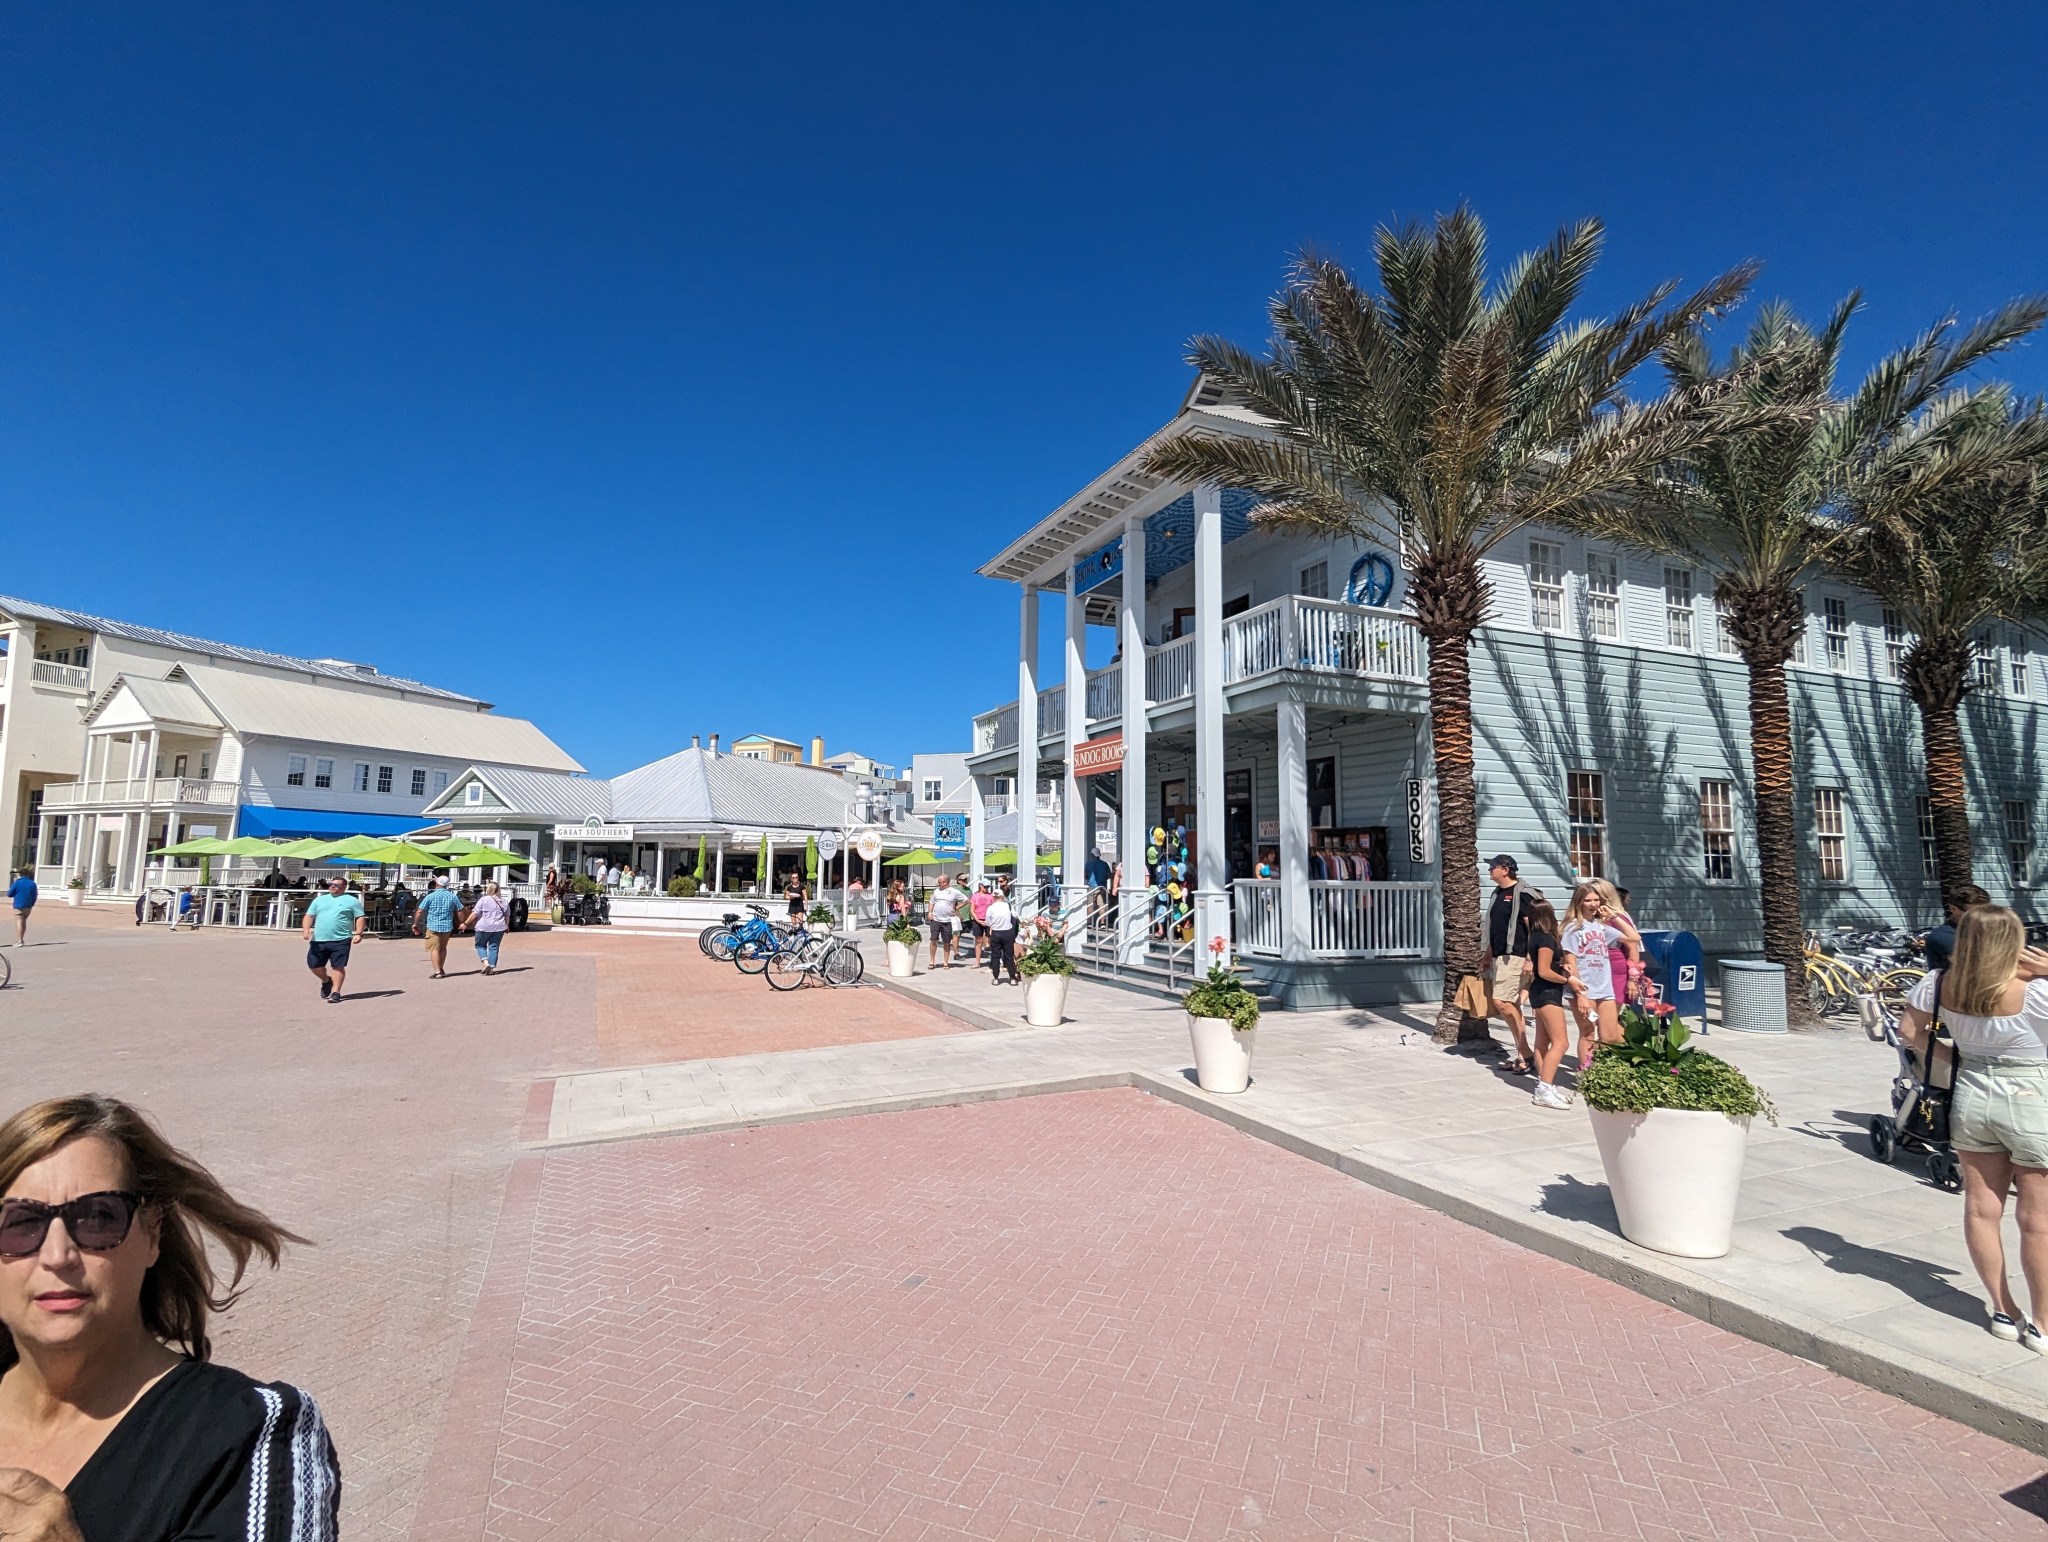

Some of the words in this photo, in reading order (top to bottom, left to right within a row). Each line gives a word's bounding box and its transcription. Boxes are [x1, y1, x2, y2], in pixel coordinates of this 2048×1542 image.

[1075, 748, 1101, 767] SUNDOG
[936, 816, 965, 828] CENTRAL
[1409, 781, 1422, 860] BOOKS
[558, 828, 582, 836] GREAT
[586, 828, 629, 836] SOUTHERN
